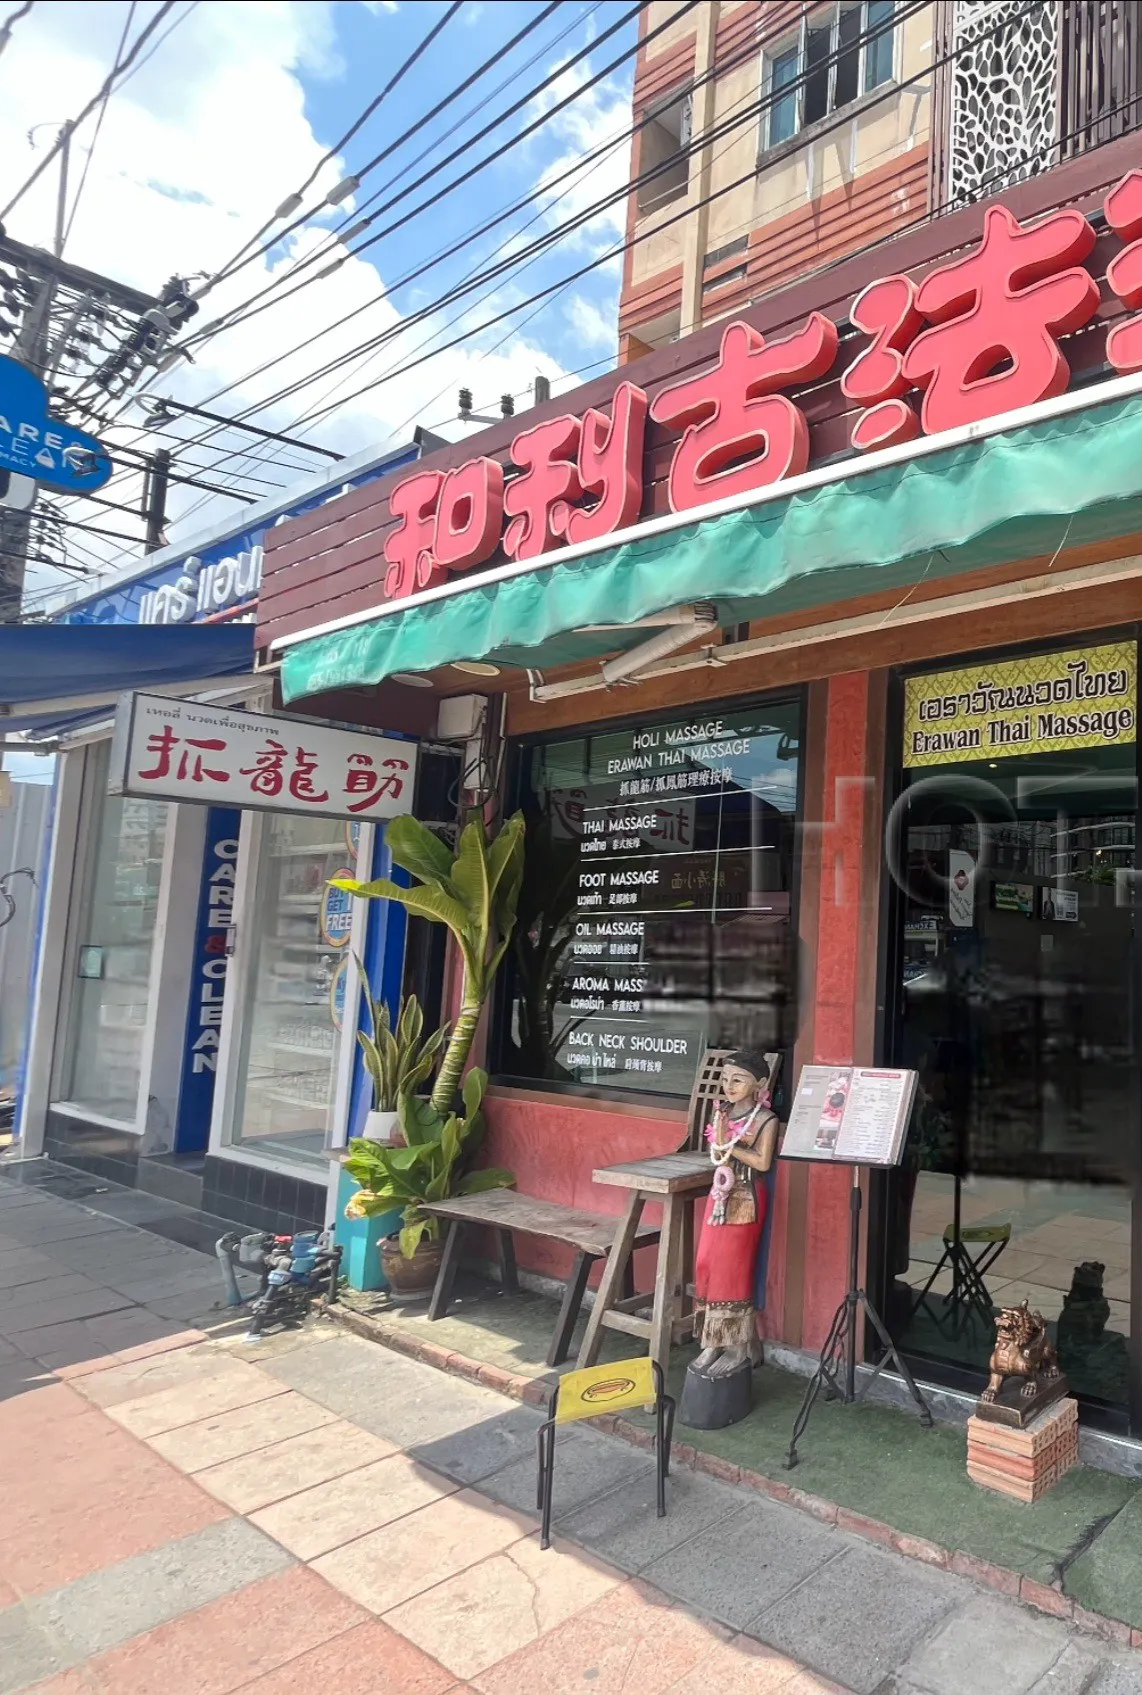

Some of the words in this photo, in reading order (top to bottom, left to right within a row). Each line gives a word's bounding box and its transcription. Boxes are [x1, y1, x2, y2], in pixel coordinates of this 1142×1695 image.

[918, 660, 1128, 722] เอราวัณนวดไทย
[632, 732, 659, 750] HOLI
[665, 721, 723, 744] MASSAGE
[911, 728, 981, 754] Erawan
[987, 715, 1031, 745] Thai
[1037, 708, 1134, 740] Massage
[607, 753, 652, 774] ERAWAN
[658, 749, 686, 766] THAI
[691, 739, 750, 762] MASSAGE
[583, 820, 605, 834] THAI
[609, 814, 657, 832] MASSAGE
[209, 838, 239, 927] CARE
[579, 873, 606, 888] FOOT
[610, 870, 659, 886] MASSAGE
[327, 900, 344, 912] GET
[326, 914, 352, 931] FREE
[575, 923, 592, 936] OIL
[596, 922, 645, 936] MASSAGE
[572, 977, 610, 991] AROMA
[614, 979, 647, 992] MASS
[191, 958, 227, 1074] CLEAN
[569, 1031, 594, 1046] BACK
[599, 1034, 626, 1049] NECK
[630, 1036, 688, 1054] SHOULDER
